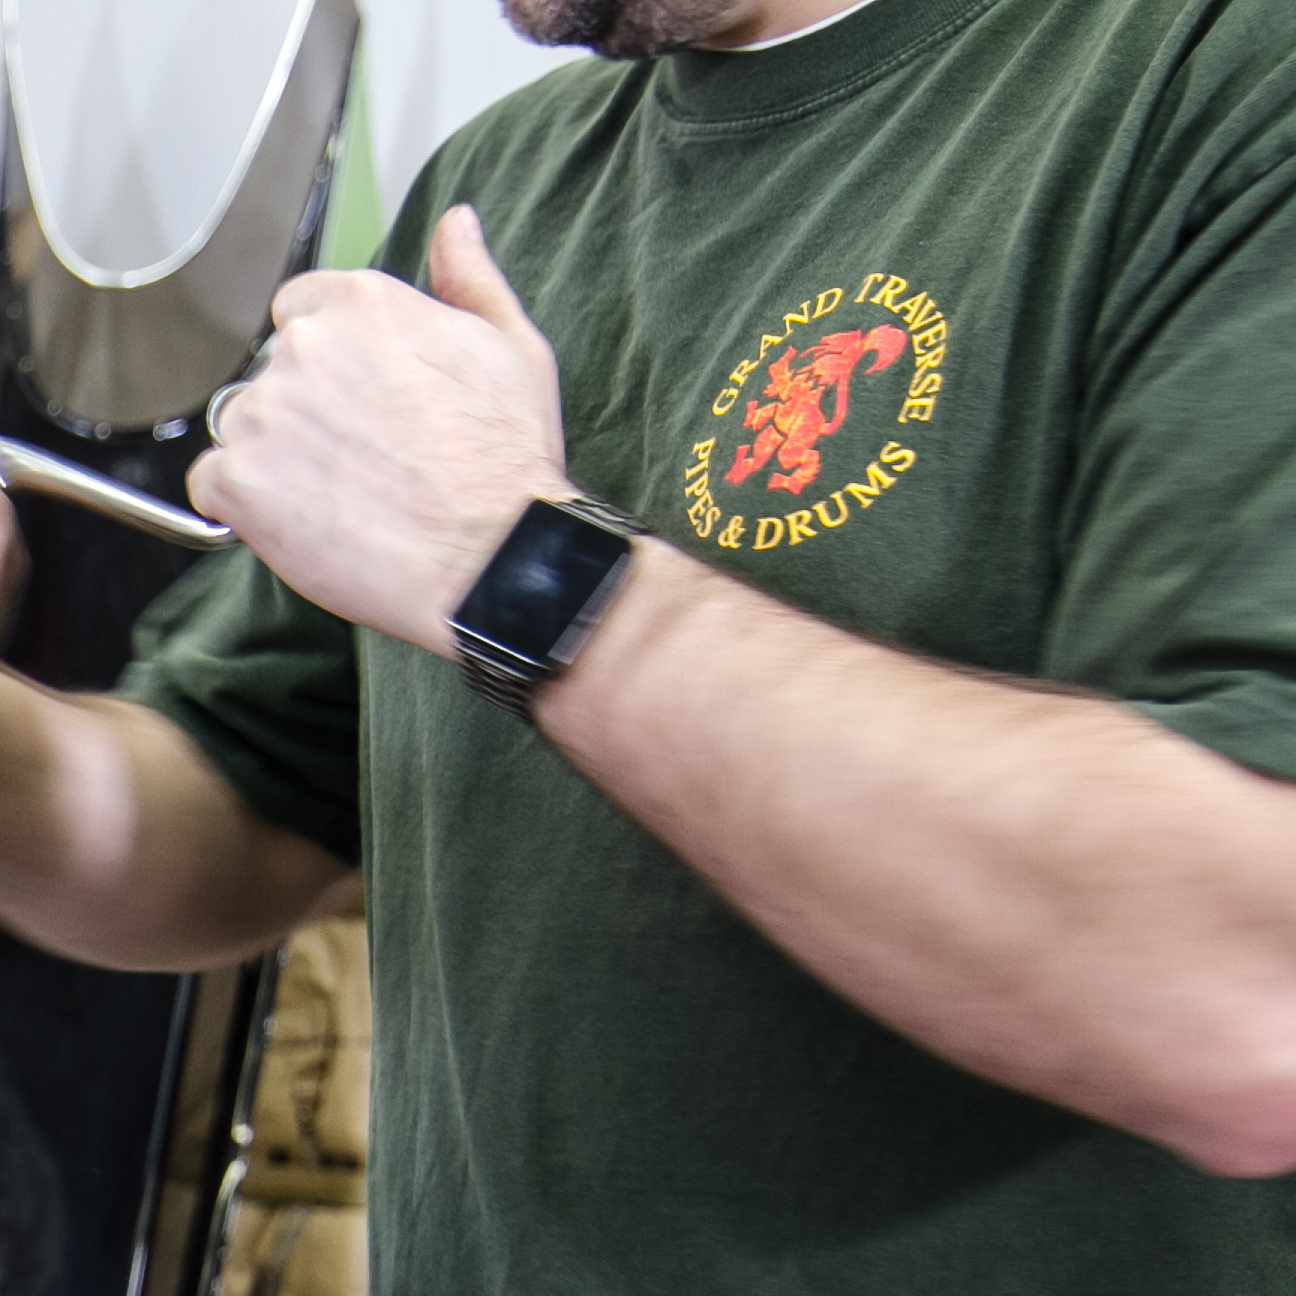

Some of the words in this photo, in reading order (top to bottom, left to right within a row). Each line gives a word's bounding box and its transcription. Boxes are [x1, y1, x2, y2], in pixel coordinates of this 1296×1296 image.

[712, 287, 843, 417] GRAND
[854, 272, 947, 423] TRAVERSE
[685, 437, 721, 538] PIPES
[718, 515, 746, 549] &
[752, 441, 916, 550] DRUMS
